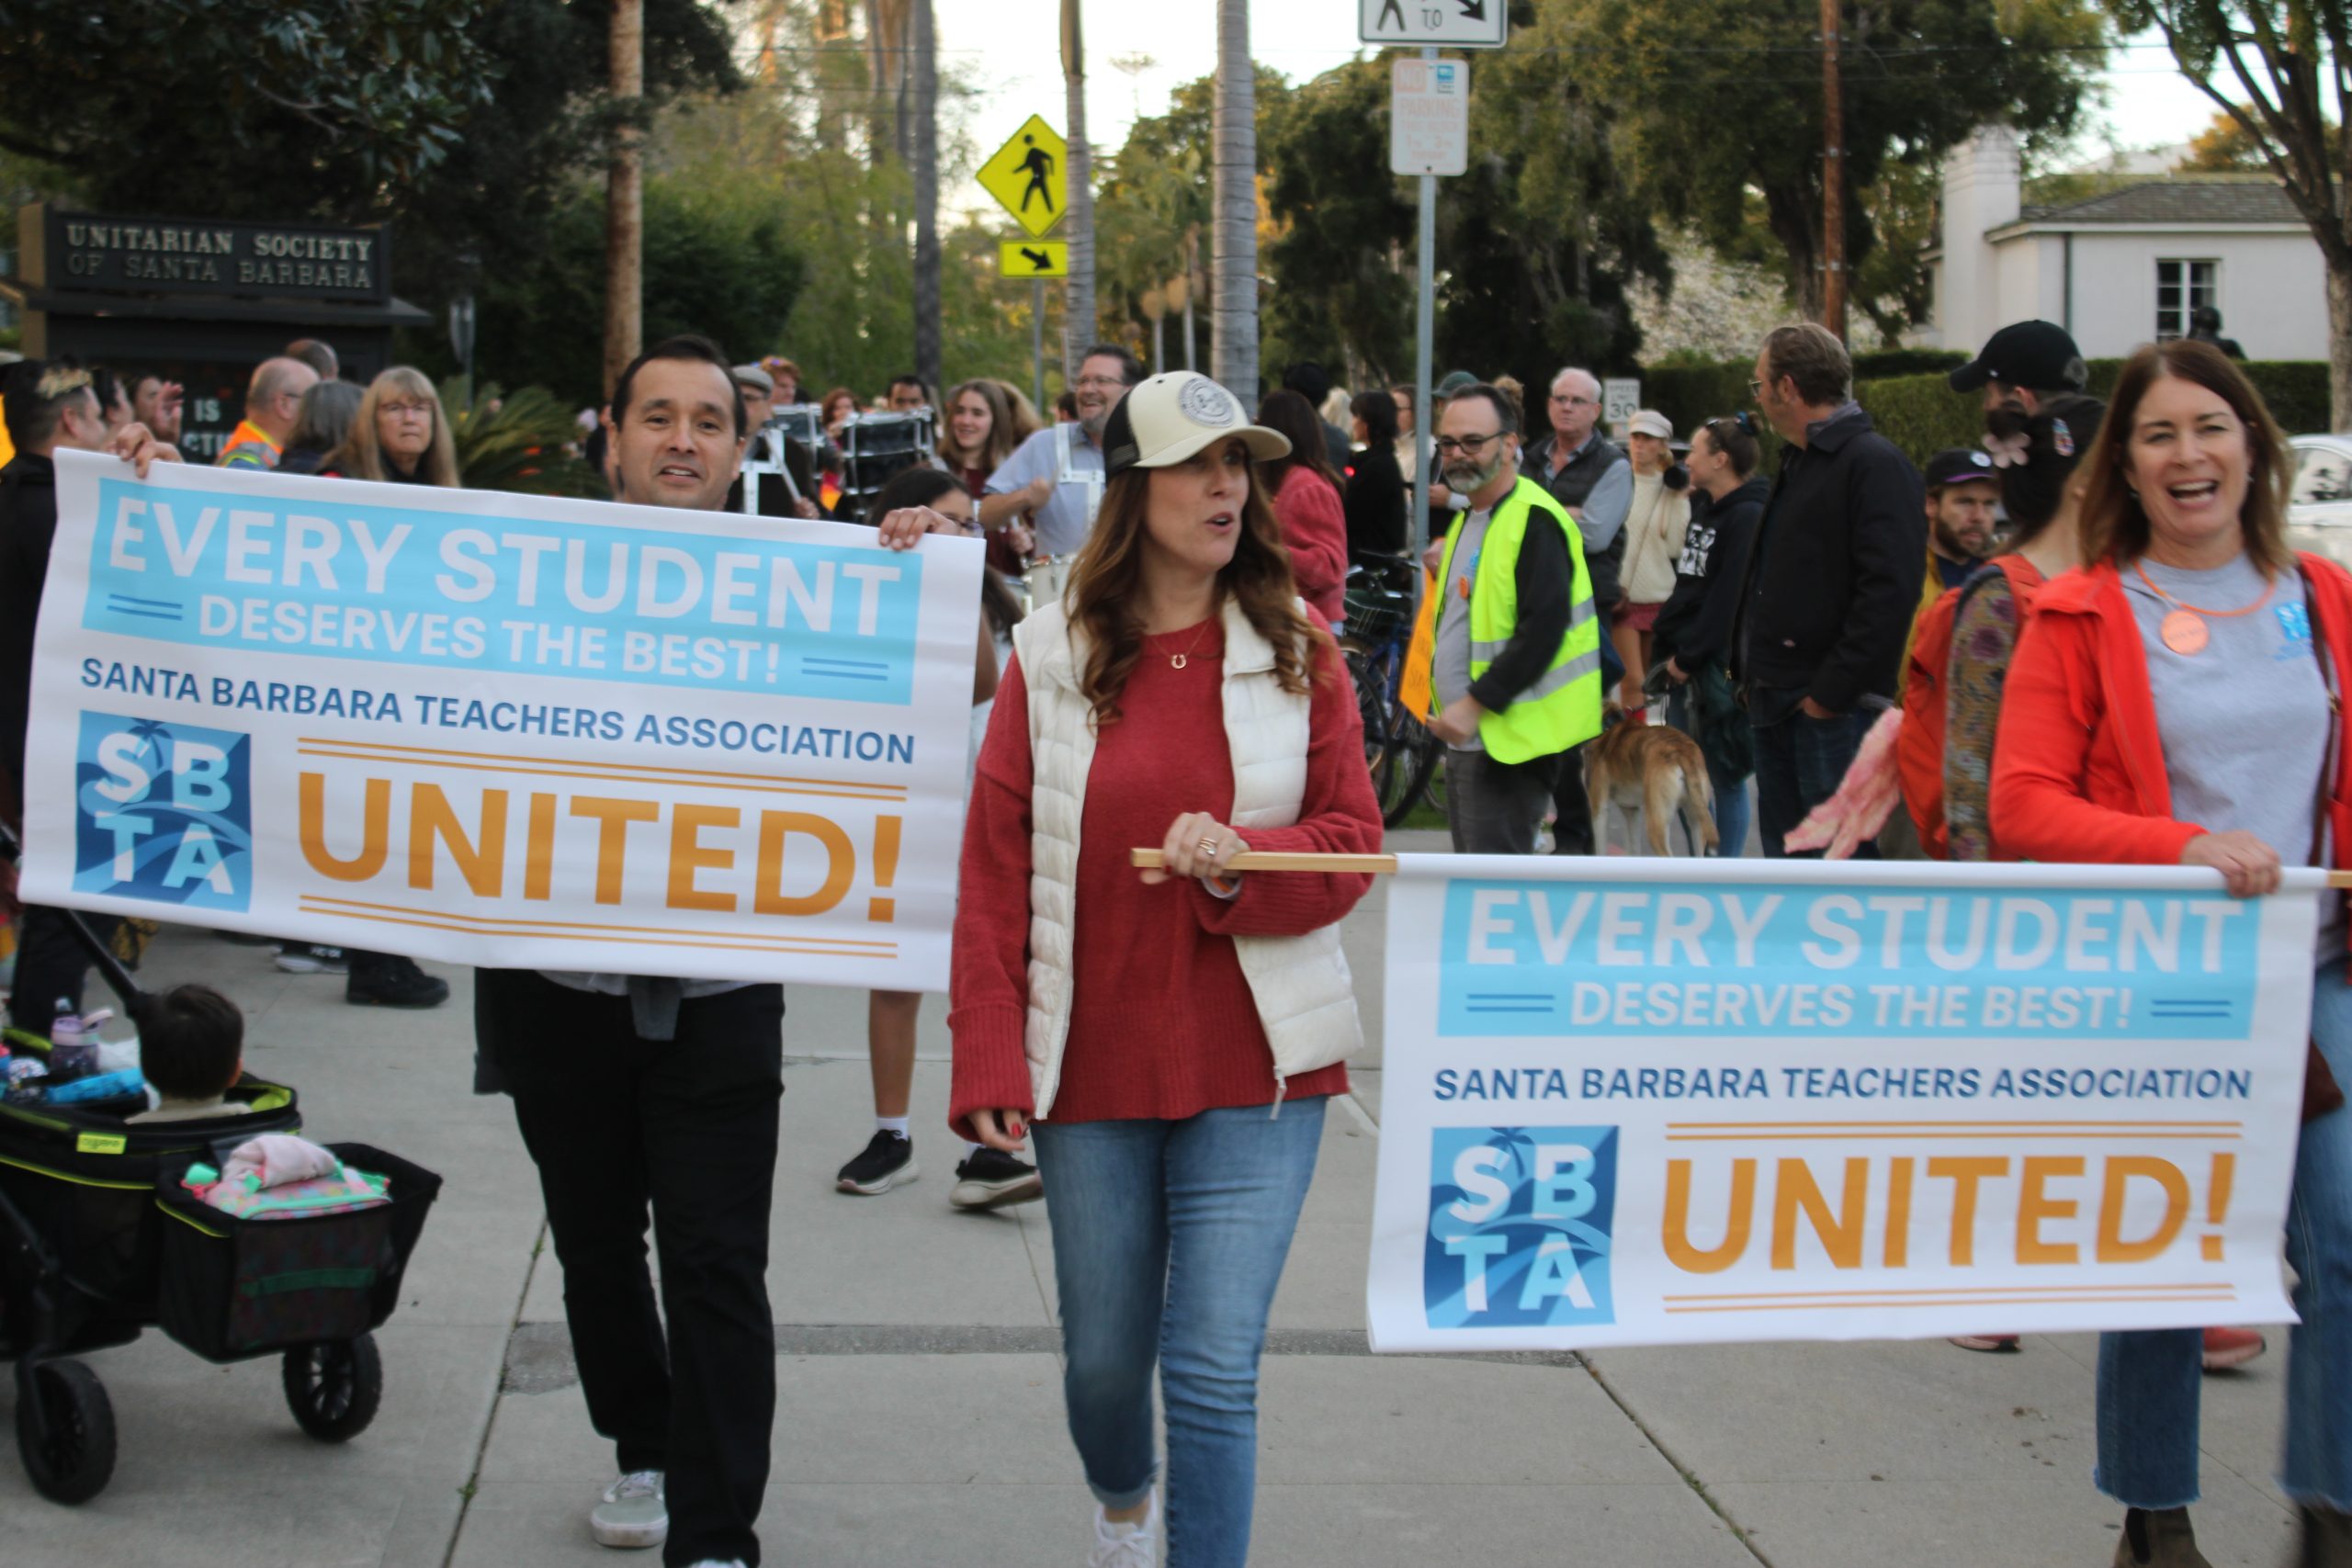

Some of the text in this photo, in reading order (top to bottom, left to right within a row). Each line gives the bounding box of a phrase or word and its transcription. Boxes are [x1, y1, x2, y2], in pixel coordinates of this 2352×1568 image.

[1420, 9, 1442, 28] TO
[67, 224, 372, 262] UNITARIAN SOCIETY
[67, 253, 372, 288] OF SANTA BARBARA
[194, 398, 220, 423] IS
[1609, 402, 1636, 419] 30
[109, 496, 901, 637] EVERY STUDENT
[198, 595, 780, 683] DESERVES THE BEST!
[81, 657, 915, 764] SANTA BARBARA TEACHERS ASSOCIATION
[298, 771, 903, 923] UNITED!
[1466, 889, 2245, 974] EVERY STUDENT
[1570, 981, 2133, 1029] DESERVES THE BEST!
[1432, 1067, 2253, 1101] SANTA BARBARA TEACHERS ASSOCIATION
[1661, 1152, 2236, 1274] UNITED!
